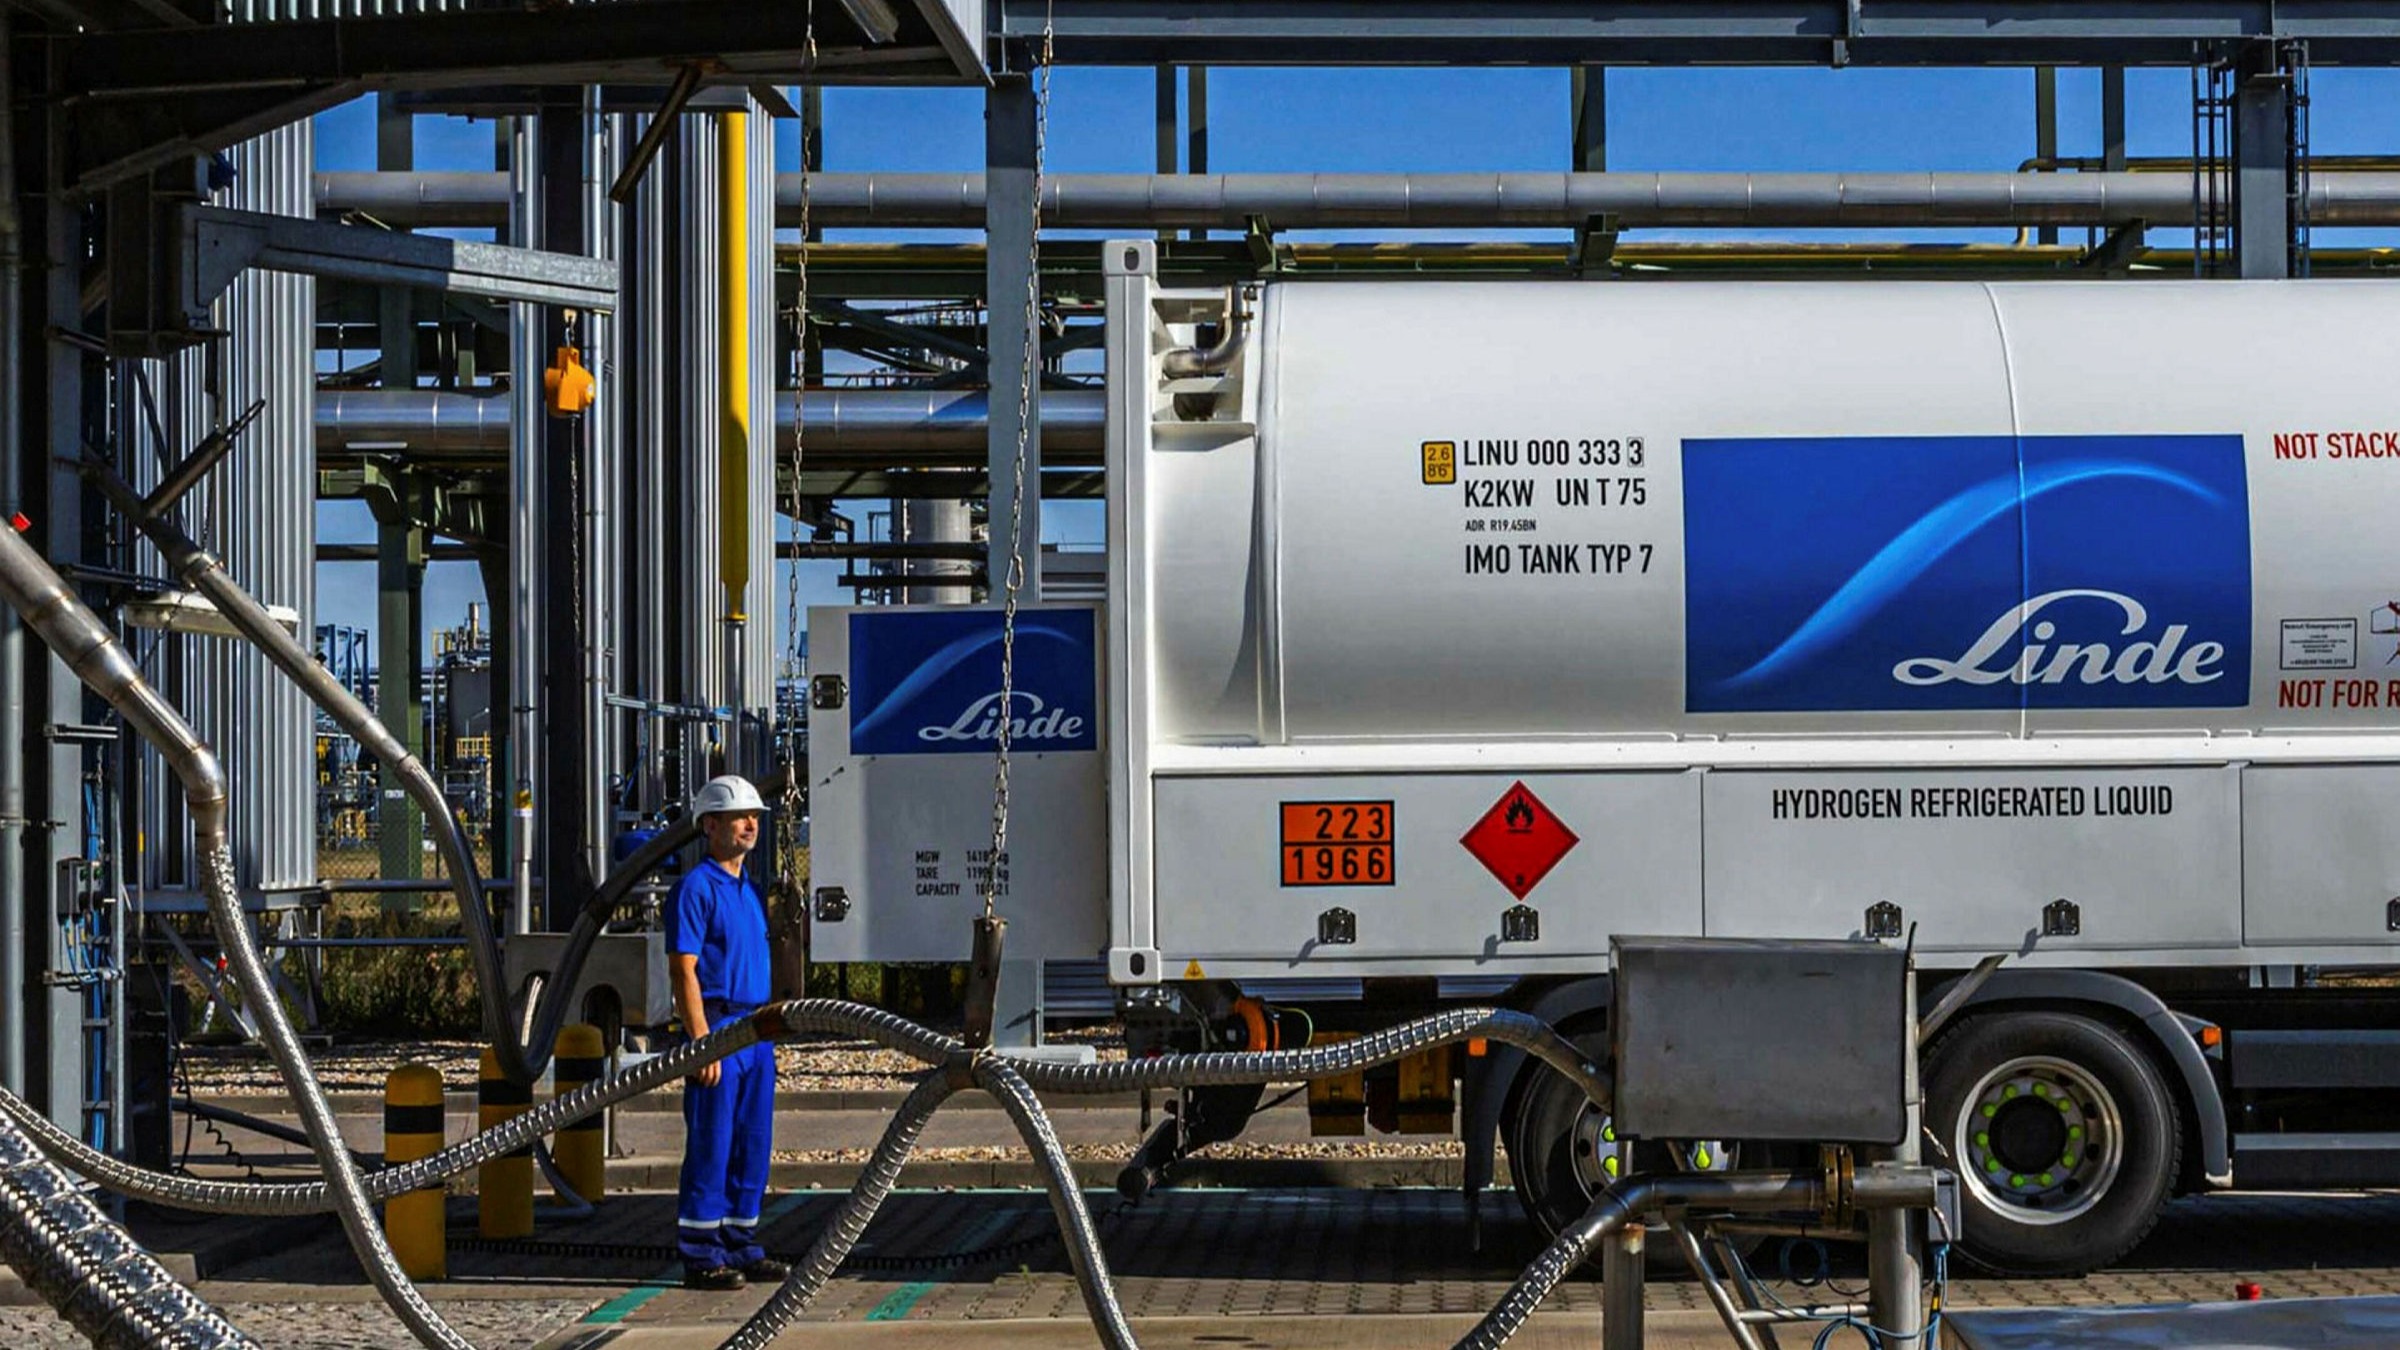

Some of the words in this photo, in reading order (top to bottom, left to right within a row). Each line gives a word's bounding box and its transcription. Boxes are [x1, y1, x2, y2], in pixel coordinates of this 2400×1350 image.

[1464, 440, 1518, 466] LINU
[1527, 440, 1570, 466] 000
[1578, 440, 1621, 466] 333
[1629, 440, 1643, 466] 3
[2274, 433, 2319, 459] NOT
[2327, 432, 2400, 458] STACK
[1465, 479, 1535, 507] K2KW
[1556, 478, 1589, 506] UN
[1596, 478, 1611, 506] T
[1618, 478, 1646, 506] 75
[1465, 519, 1485, 532] ADR
[1465, 545, 1510, 574] IMO
[1518, 544, 1581, 574] TANK
[1587, 544, 1632, 574] TYP
[1639, 544, 1653, 574] 7
[1892, 589, 2224, 685] Linde
[2278, 680, 2326, 708] NOT
[2332, 680, 2379, 708] FOR
[918, 691, 1083, 741] Linde
[1772, 789, 1901, 819] HYDROGEN
[1910, 787, 2085, 818] REFRIGERATED
[2095, 786, 2173, 816] LIQUID
[1315, 807, 1385, 840] 223
[916, 851, 940, 863] MGW
[1292, 848, 1385, 880] 1966
[916, 867, 939, 879] TARE
[916, 883, 960, 896] CAPACITY
